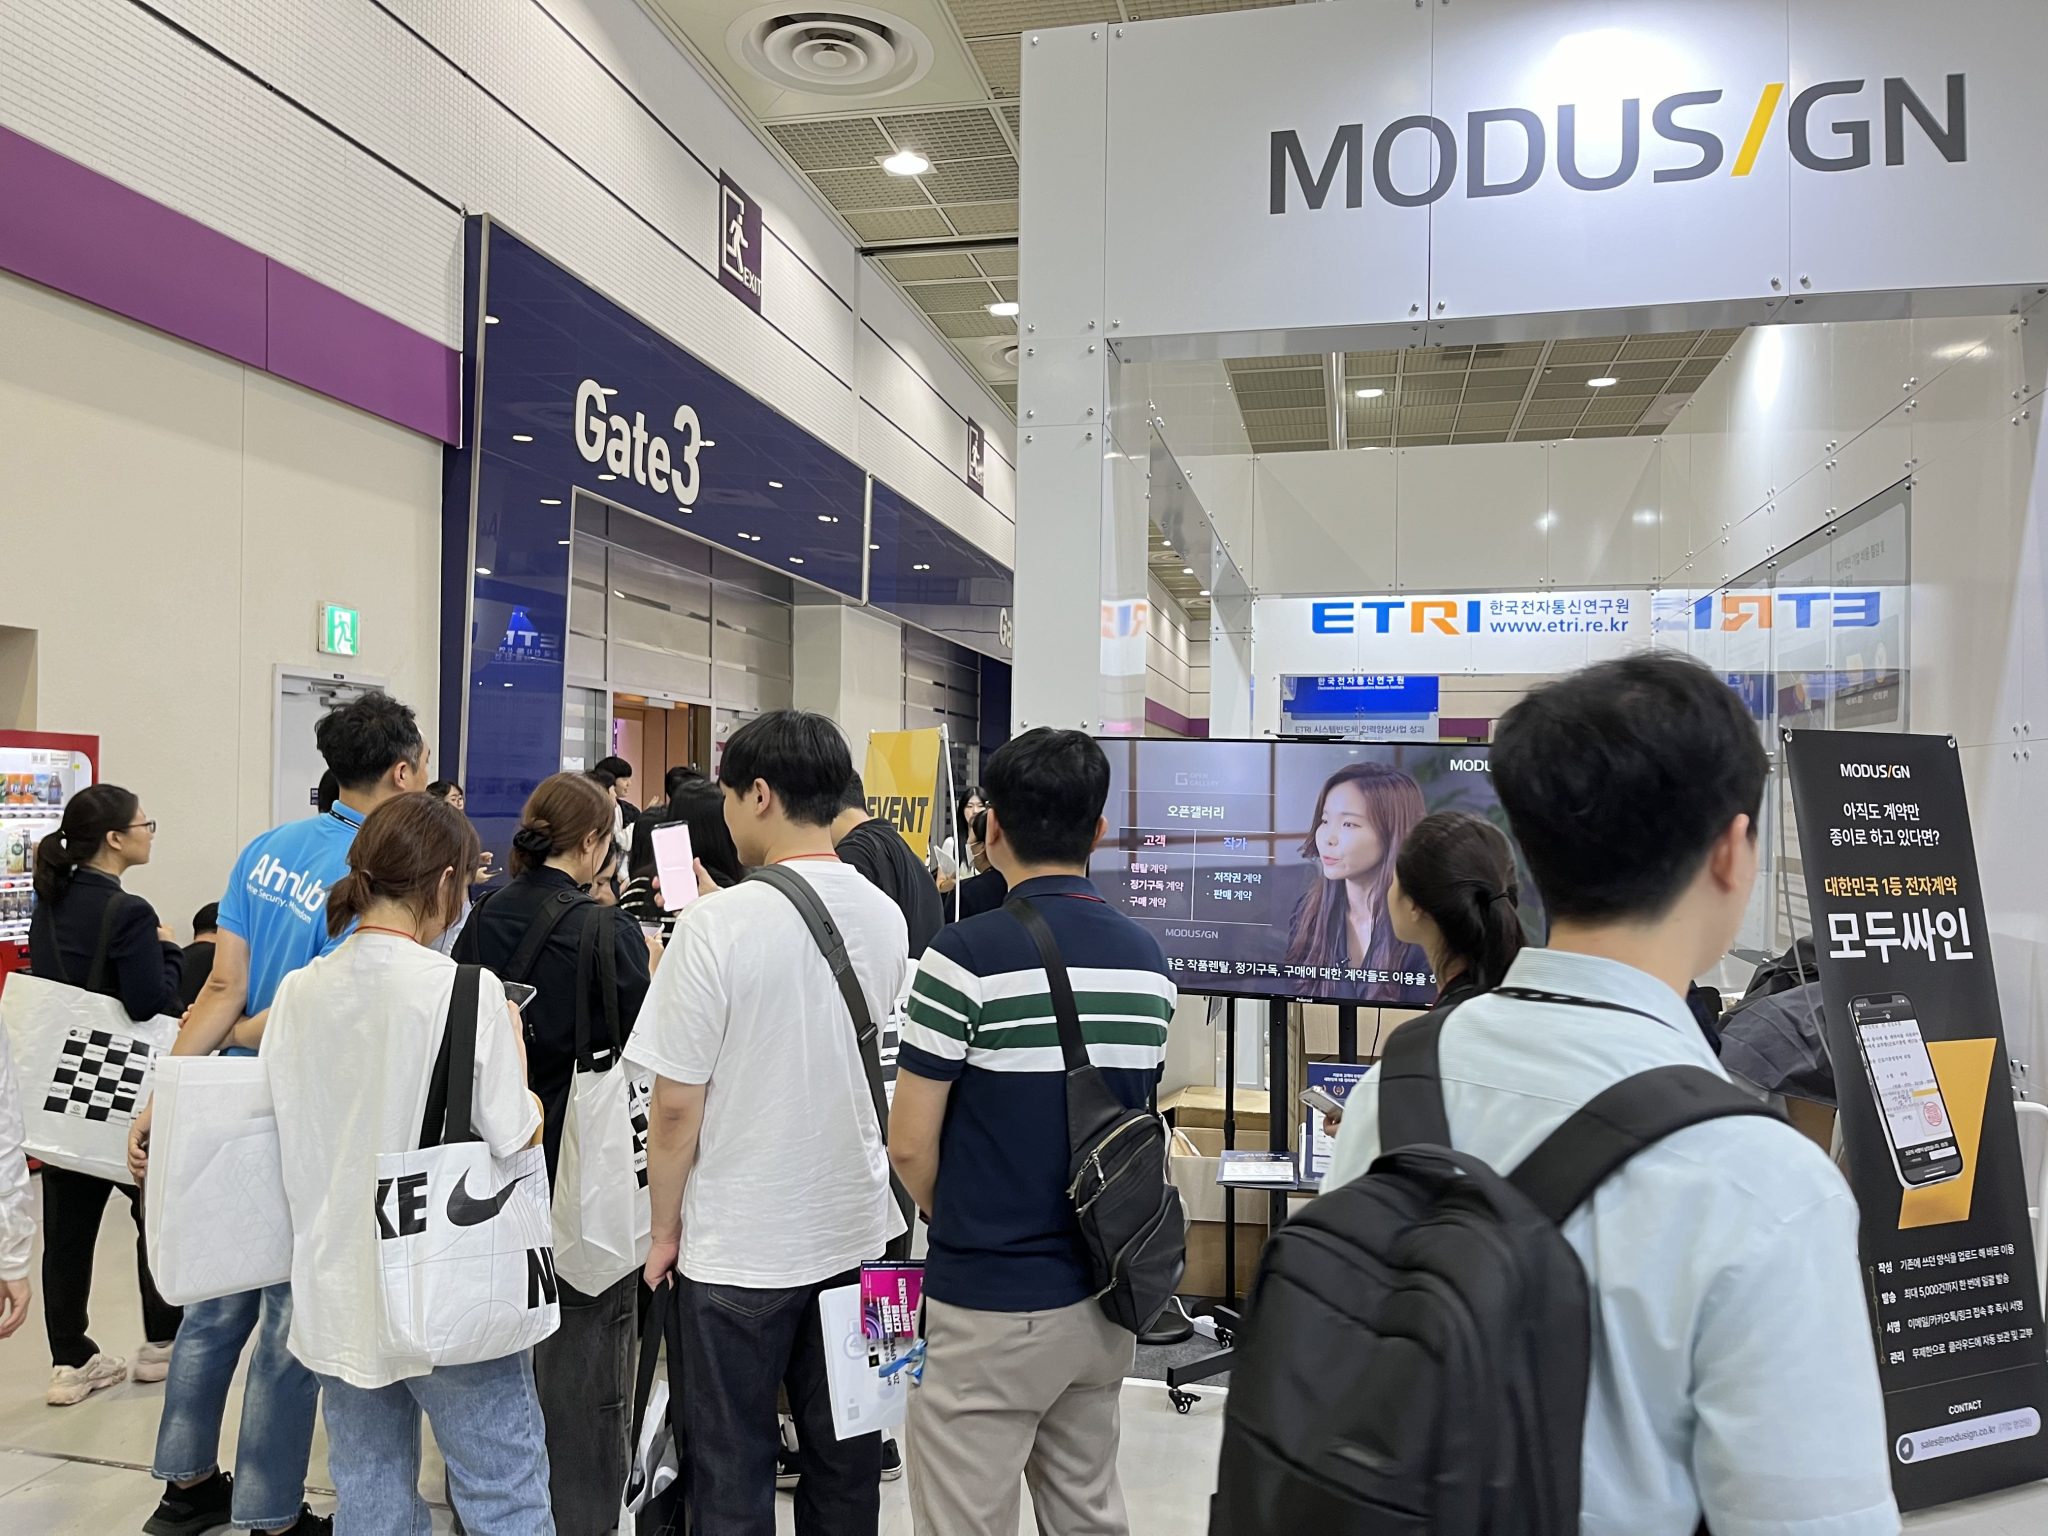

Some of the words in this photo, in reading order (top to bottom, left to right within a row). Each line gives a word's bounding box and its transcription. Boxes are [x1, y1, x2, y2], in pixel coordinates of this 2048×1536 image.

[743, 266, 761, 297] EXIT
[1490, 598, 1629, 616] 한국전자통신연구원
[1312, 600, 1481, 635] ETRI
[1490, 617, 1629, 632] www.etri.re.kr
[1295, 725, 1312, 733] ETRI
[867, 797, 929, 833] EVENT
[1167, 805, 1224, 819] 오픈갤러리
[1843, 802, 1881, 820] 아직도
[1883, 803, 1920, 821] 계약만
[1143, 834, 1166, 847] 고객
[1223, 837, 1248, 850] 작가
[1829, 828, 1867, 847] 종이로
[1869, 828, 1895, 846] 하고
[1897, 828, 1940, 847] 있다면?
[1150, 863, 1168, 874] 계약
[1214, 872, 1241, 883] 저작권
[1243, 873, 1262, 884] 계약
[1130, 880, 1164, 891] 정기구독
[1166, 881, 1184, 892] 계약
[1824, 876, 1878, 897] 대한민국
[1881, 877, 1902, 896] 1등
[1905, 876, 1957, 896] 전자계약
[1129, 896, 1147, 907] 구매
[1148, 897, 1166, 908] 계약
[1213, 889, 1232, 900] 판매
[1233, 890, 1252, 901] 계약
[1828, 907, 1973, 963] 모두싸인
[1187, 958, 1232, 975] 작품렌탈,
[1235, 961, 1281, 978] 정기구독,
[1283, 964, 1317, 979] 구매에
[1319, 966, 1341, 981] 대한
[1344, 968, 1389, 983] 계약들도
[1392, 971, 1426, 987] 이용을
[1878, 1261, 1893, 1275] 작성
[1900, 1257, 1921, 1270] 기존에
[1936, 1252, 1957, 1265] 양식을
[2000, 1243, 2014, 1255] 이용
[1886, 1320, 1900, 1333] 서명
[1948, 1400, 1982, 1415] CONTACT
[1920, 1425, 1996, 1449] sales@modusign.co.kr
